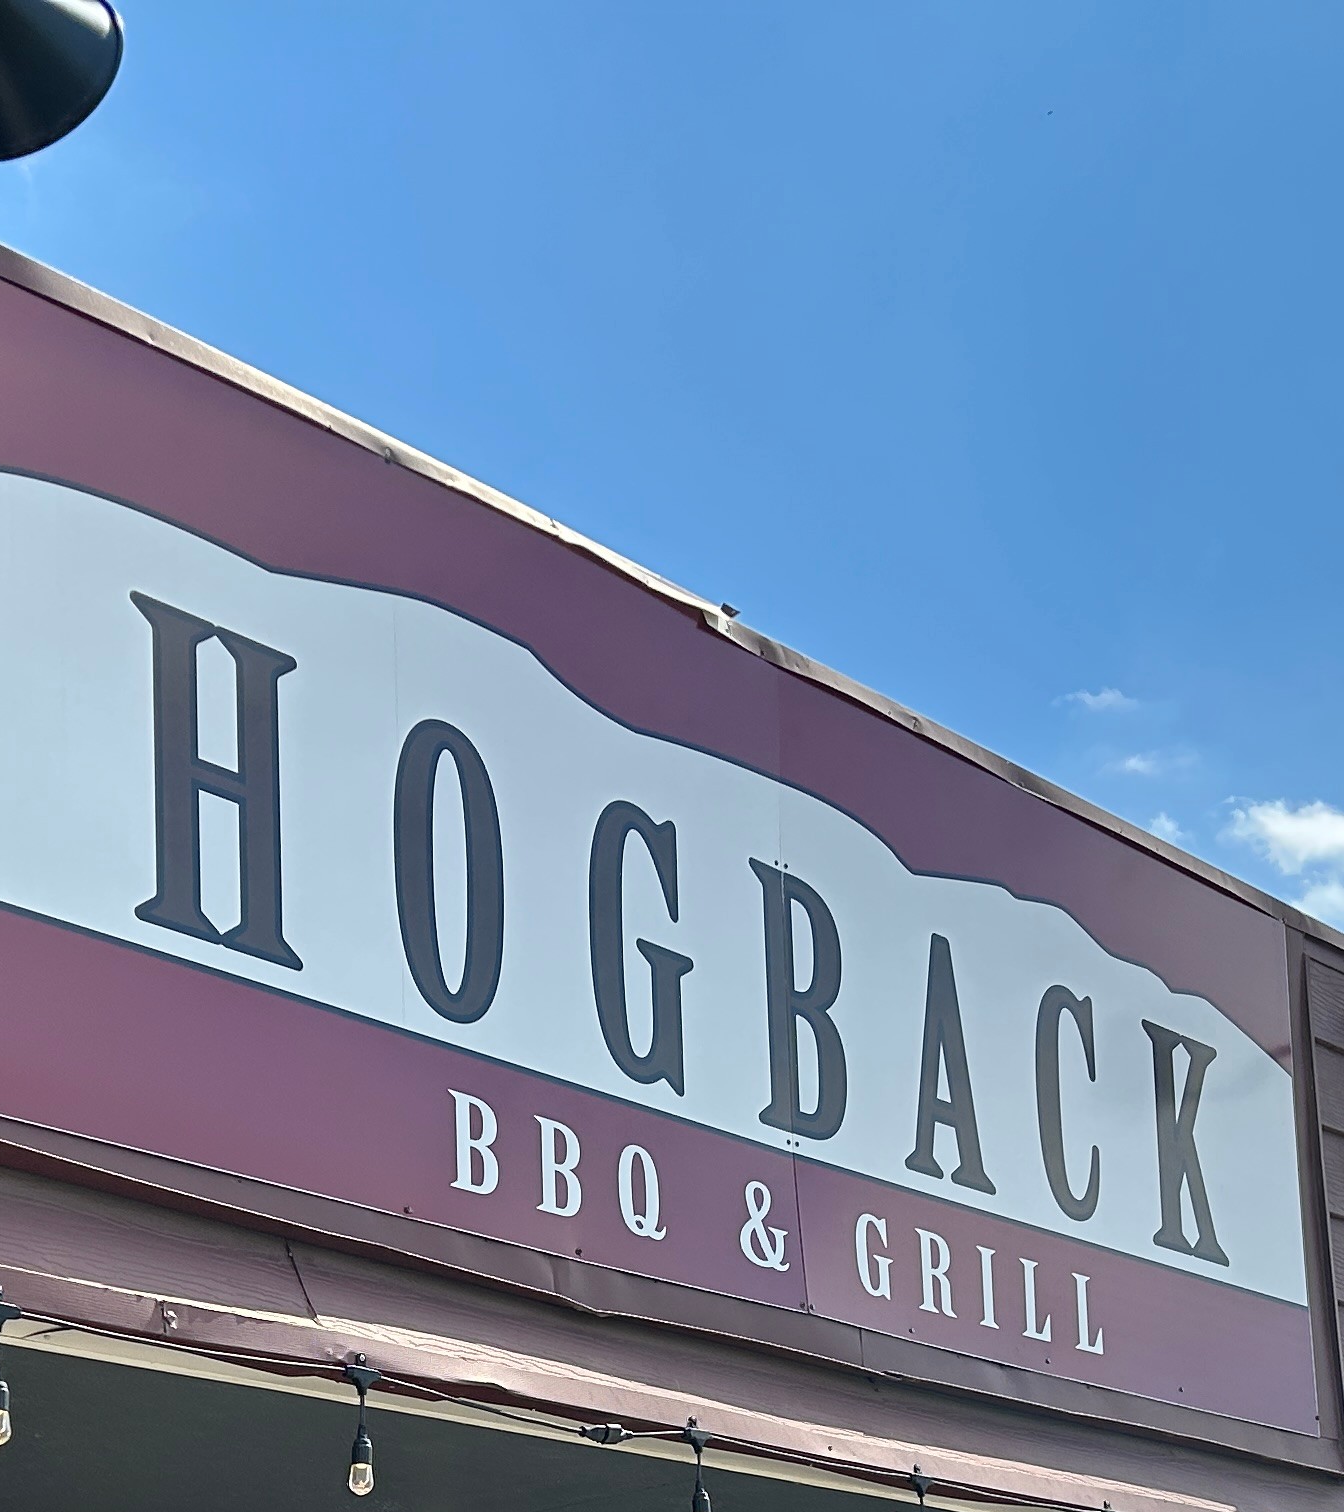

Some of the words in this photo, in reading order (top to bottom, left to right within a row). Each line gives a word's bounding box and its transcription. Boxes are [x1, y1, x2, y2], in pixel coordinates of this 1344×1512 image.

[130, 591, 1230, 1267] HOGBACK
[447, 1088, 667, 1241] BBQ
[739, 1180, 789, 1272] &
[855, 1213, 1104, 1355] GRILL
